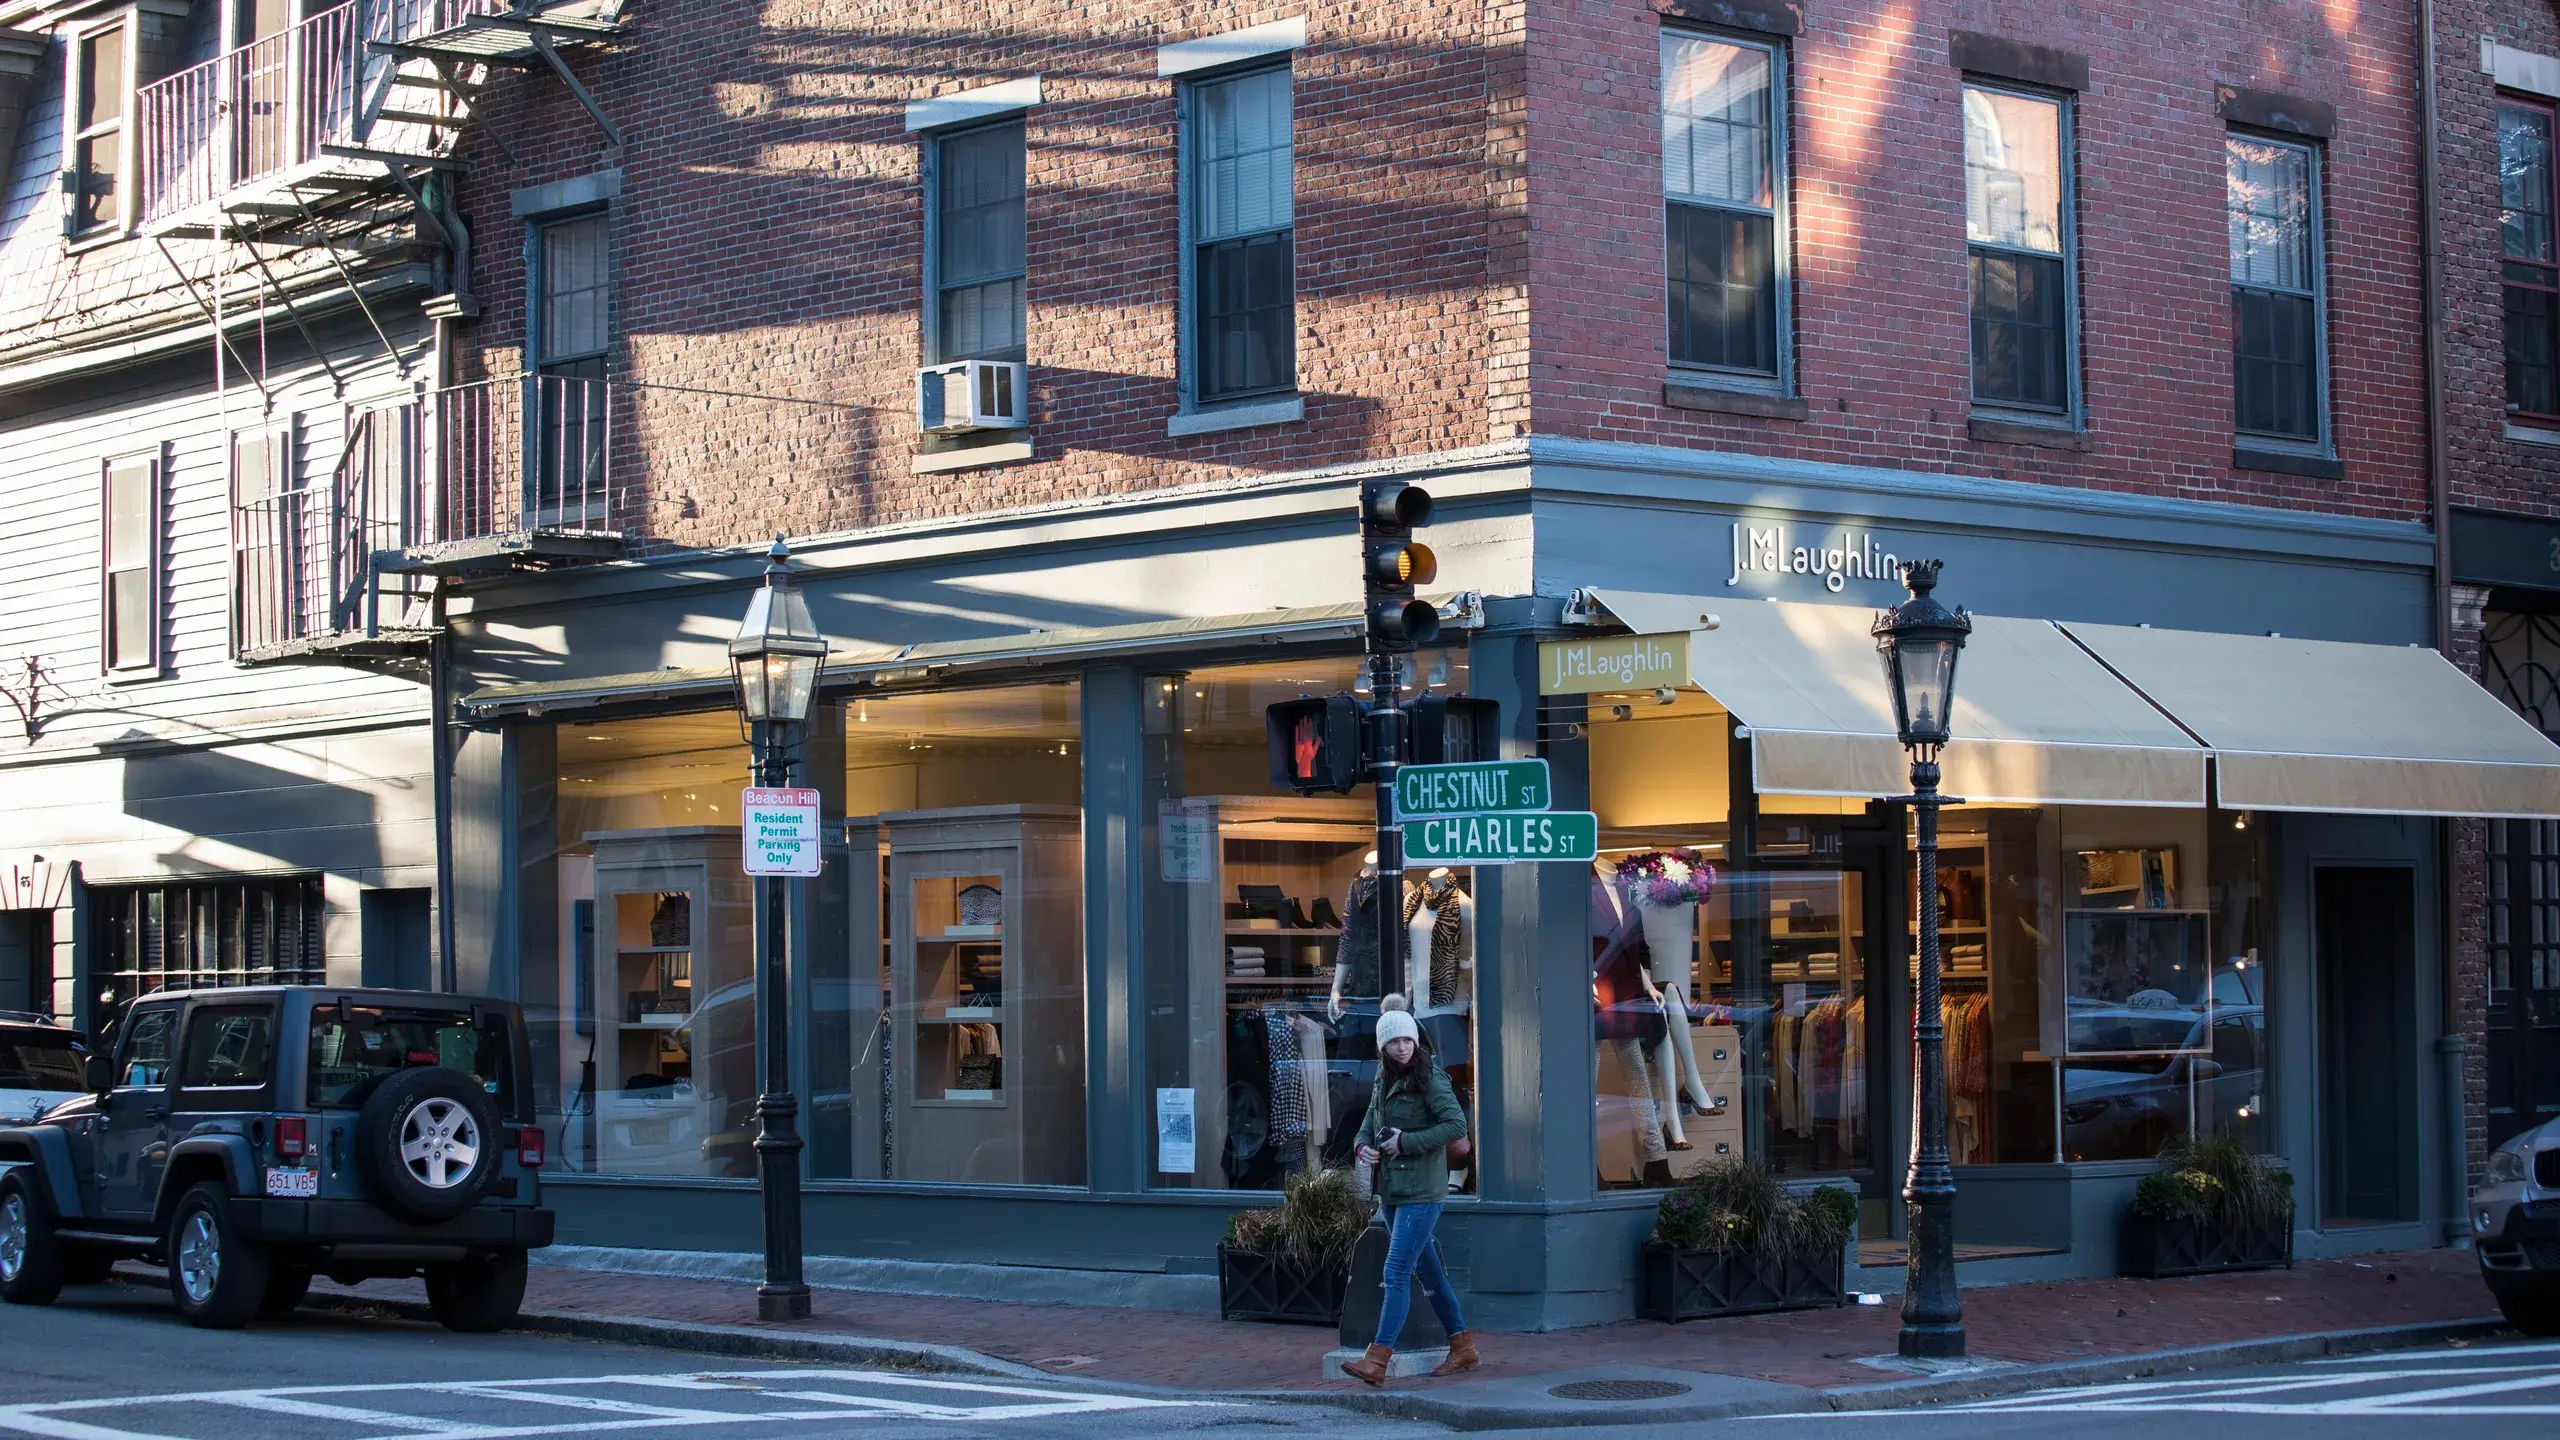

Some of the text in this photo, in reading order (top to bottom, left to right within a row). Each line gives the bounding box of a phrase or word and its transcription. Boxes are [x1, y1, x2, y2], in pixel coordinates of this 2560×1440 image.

[1406, 769, 1536, 810] CHESTNUT ST
[746, 791, 817, 805] Beacon Hill
[754, 812, 803, 824] Resident
[760, 825, 798, 837] Permit
[1424, 818, 1576, 854] CHARLES ST
[757, 839, 801, 852] Parking
[767, 852, 792, 865] Only
[268, 1174, 316, 1190] 651 VB5
